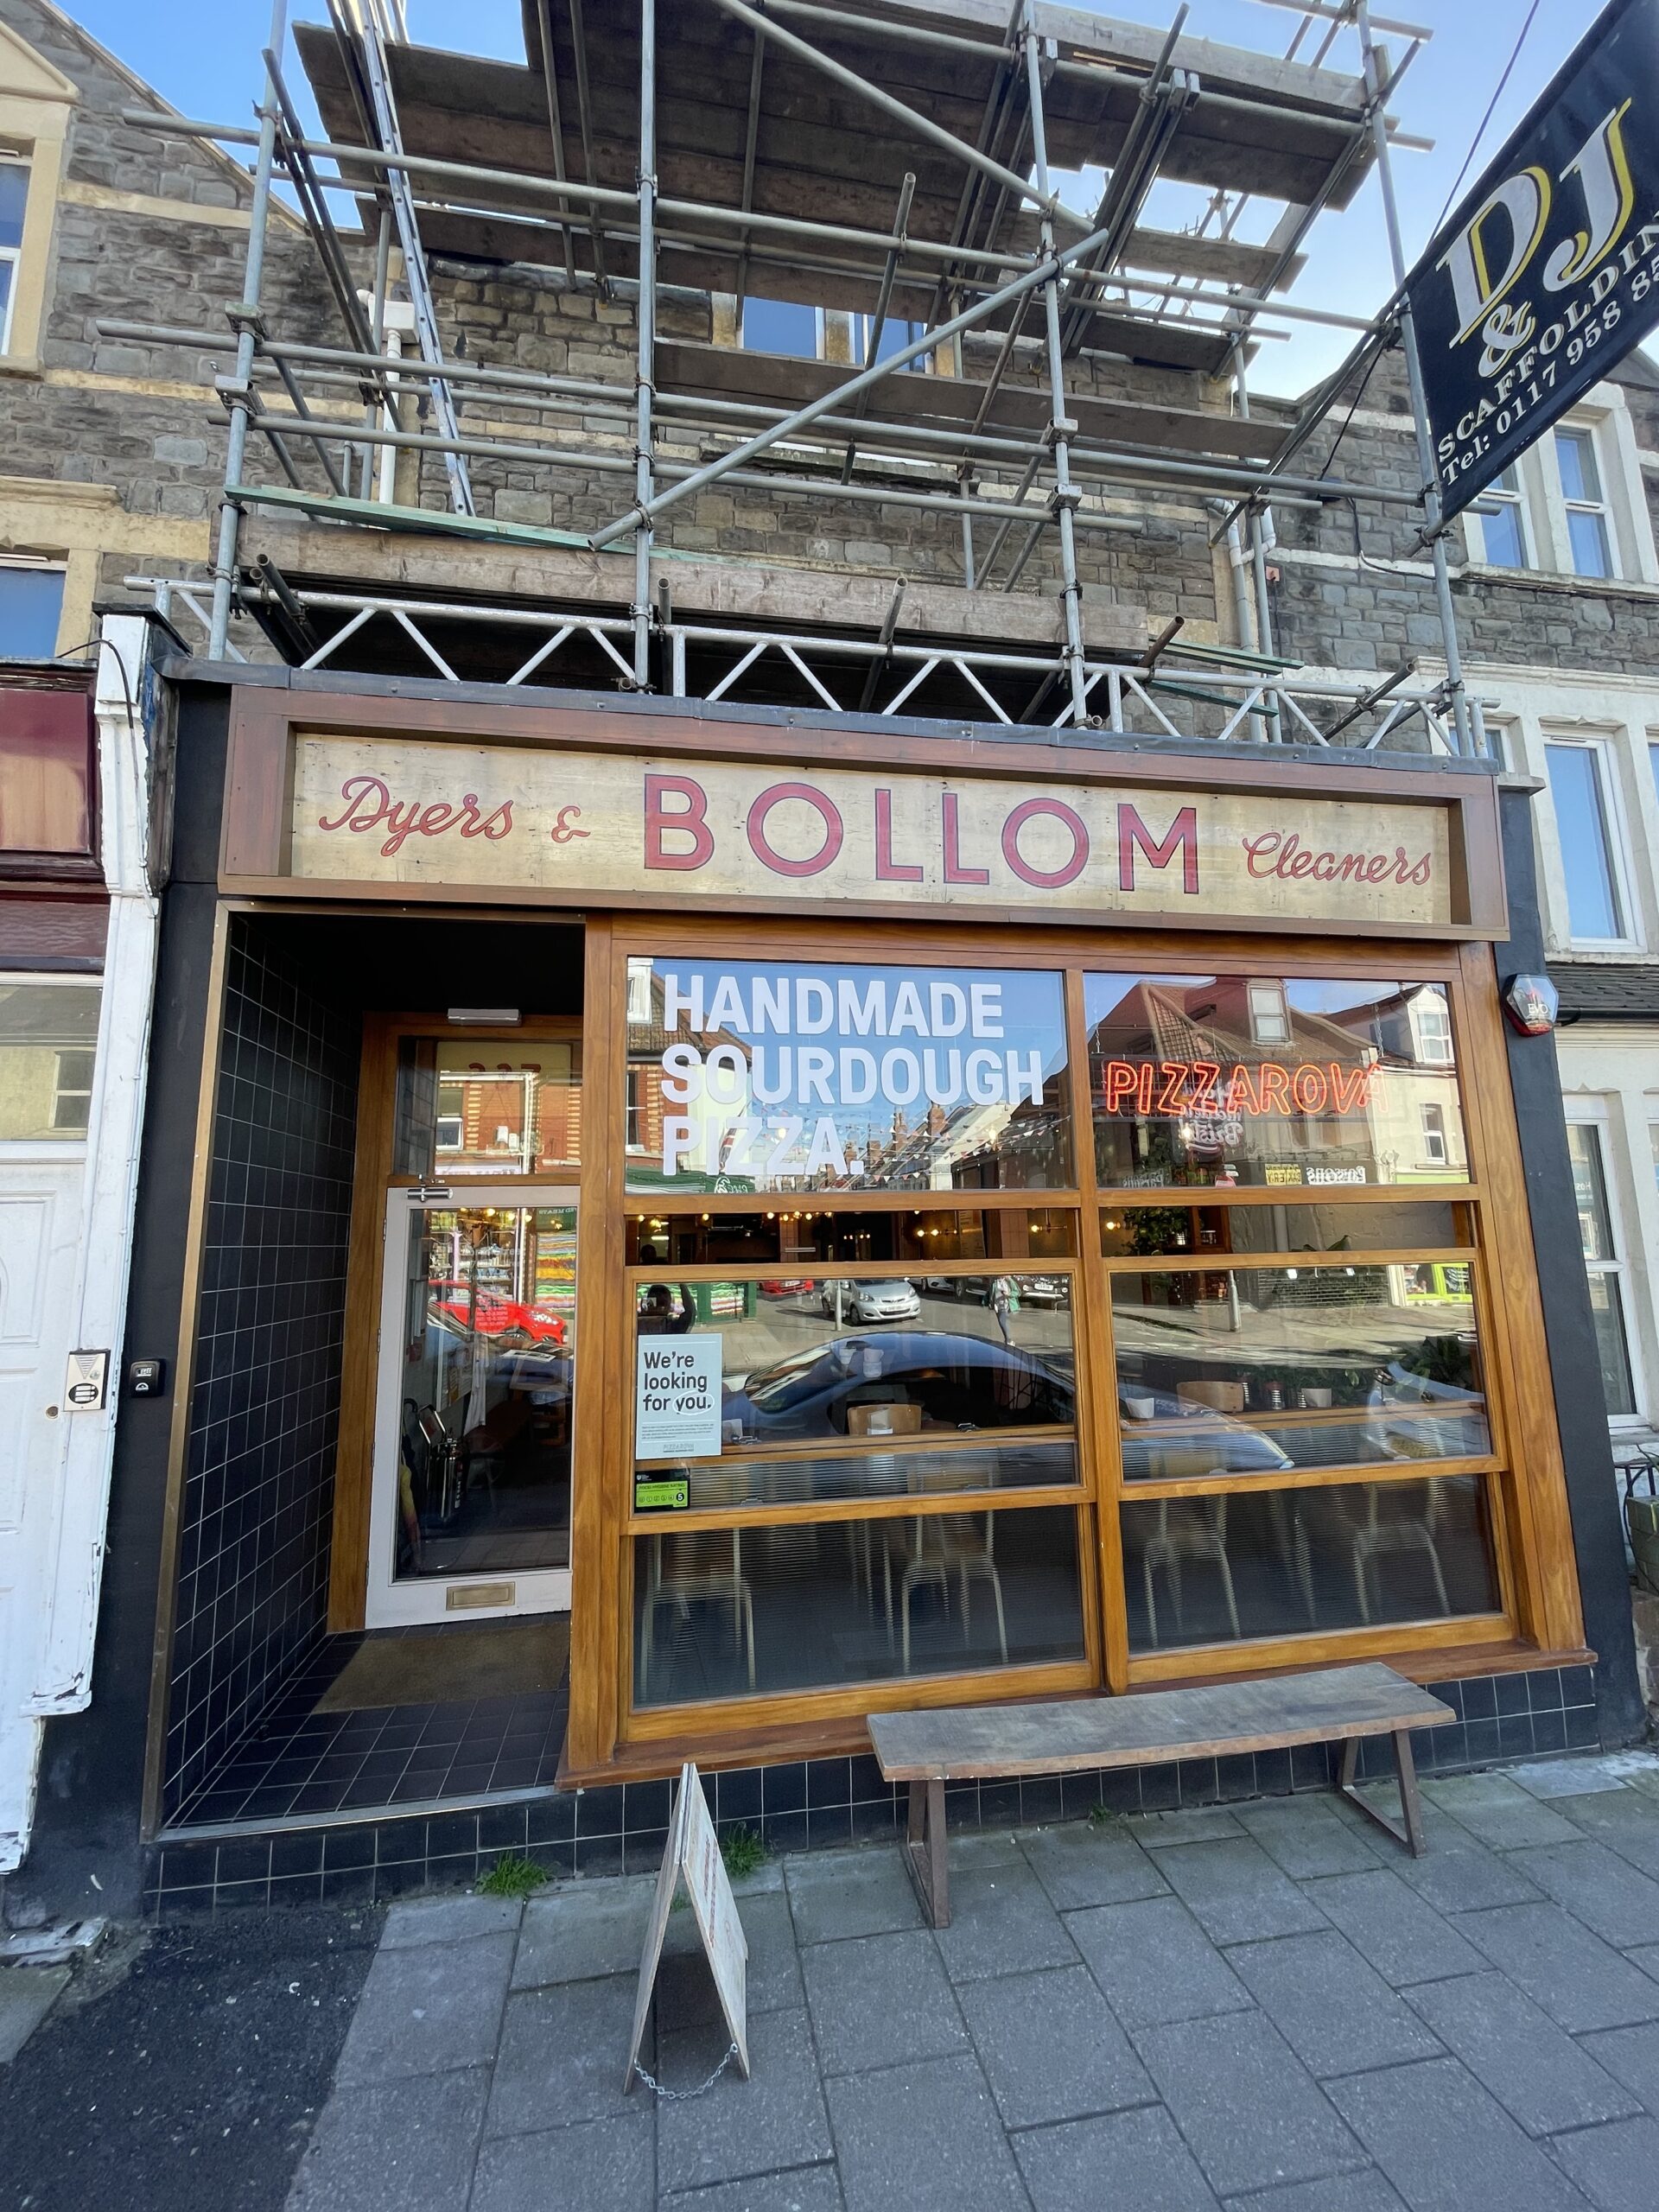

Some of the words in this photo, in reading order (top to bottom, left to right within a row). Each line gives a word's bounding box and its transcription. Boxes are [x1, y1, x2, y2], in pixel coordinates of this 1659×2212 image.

[1478, 301, 1536, 378] &
[1442, 434, 1491, 486] Tel:
[1497, 361, 1556, 435] 0117
[1567, 300, 1621, 365] 958
[319, 776, 514, 857] Dyers
[551, 805, 591, 843] &
[644, 773, 1199, 895] BOLLOM
[1242, 831, 1432, 886] Cleaners
[664, 974, 1004, 1038] HANDMADE
[1527, 1003, 1548, 1014] EVO
[661, 1043, 1044, 1106] SOURDOUGH
[1105, 1060, 1389, 1116] PIZZAROVA
[663, 1116, 865, 1176] PIZZA.
[643, 1394, 671, 1411] for
[676, 1395, 712, 1414] you.
[644, 1372, 708, 1392] looking
